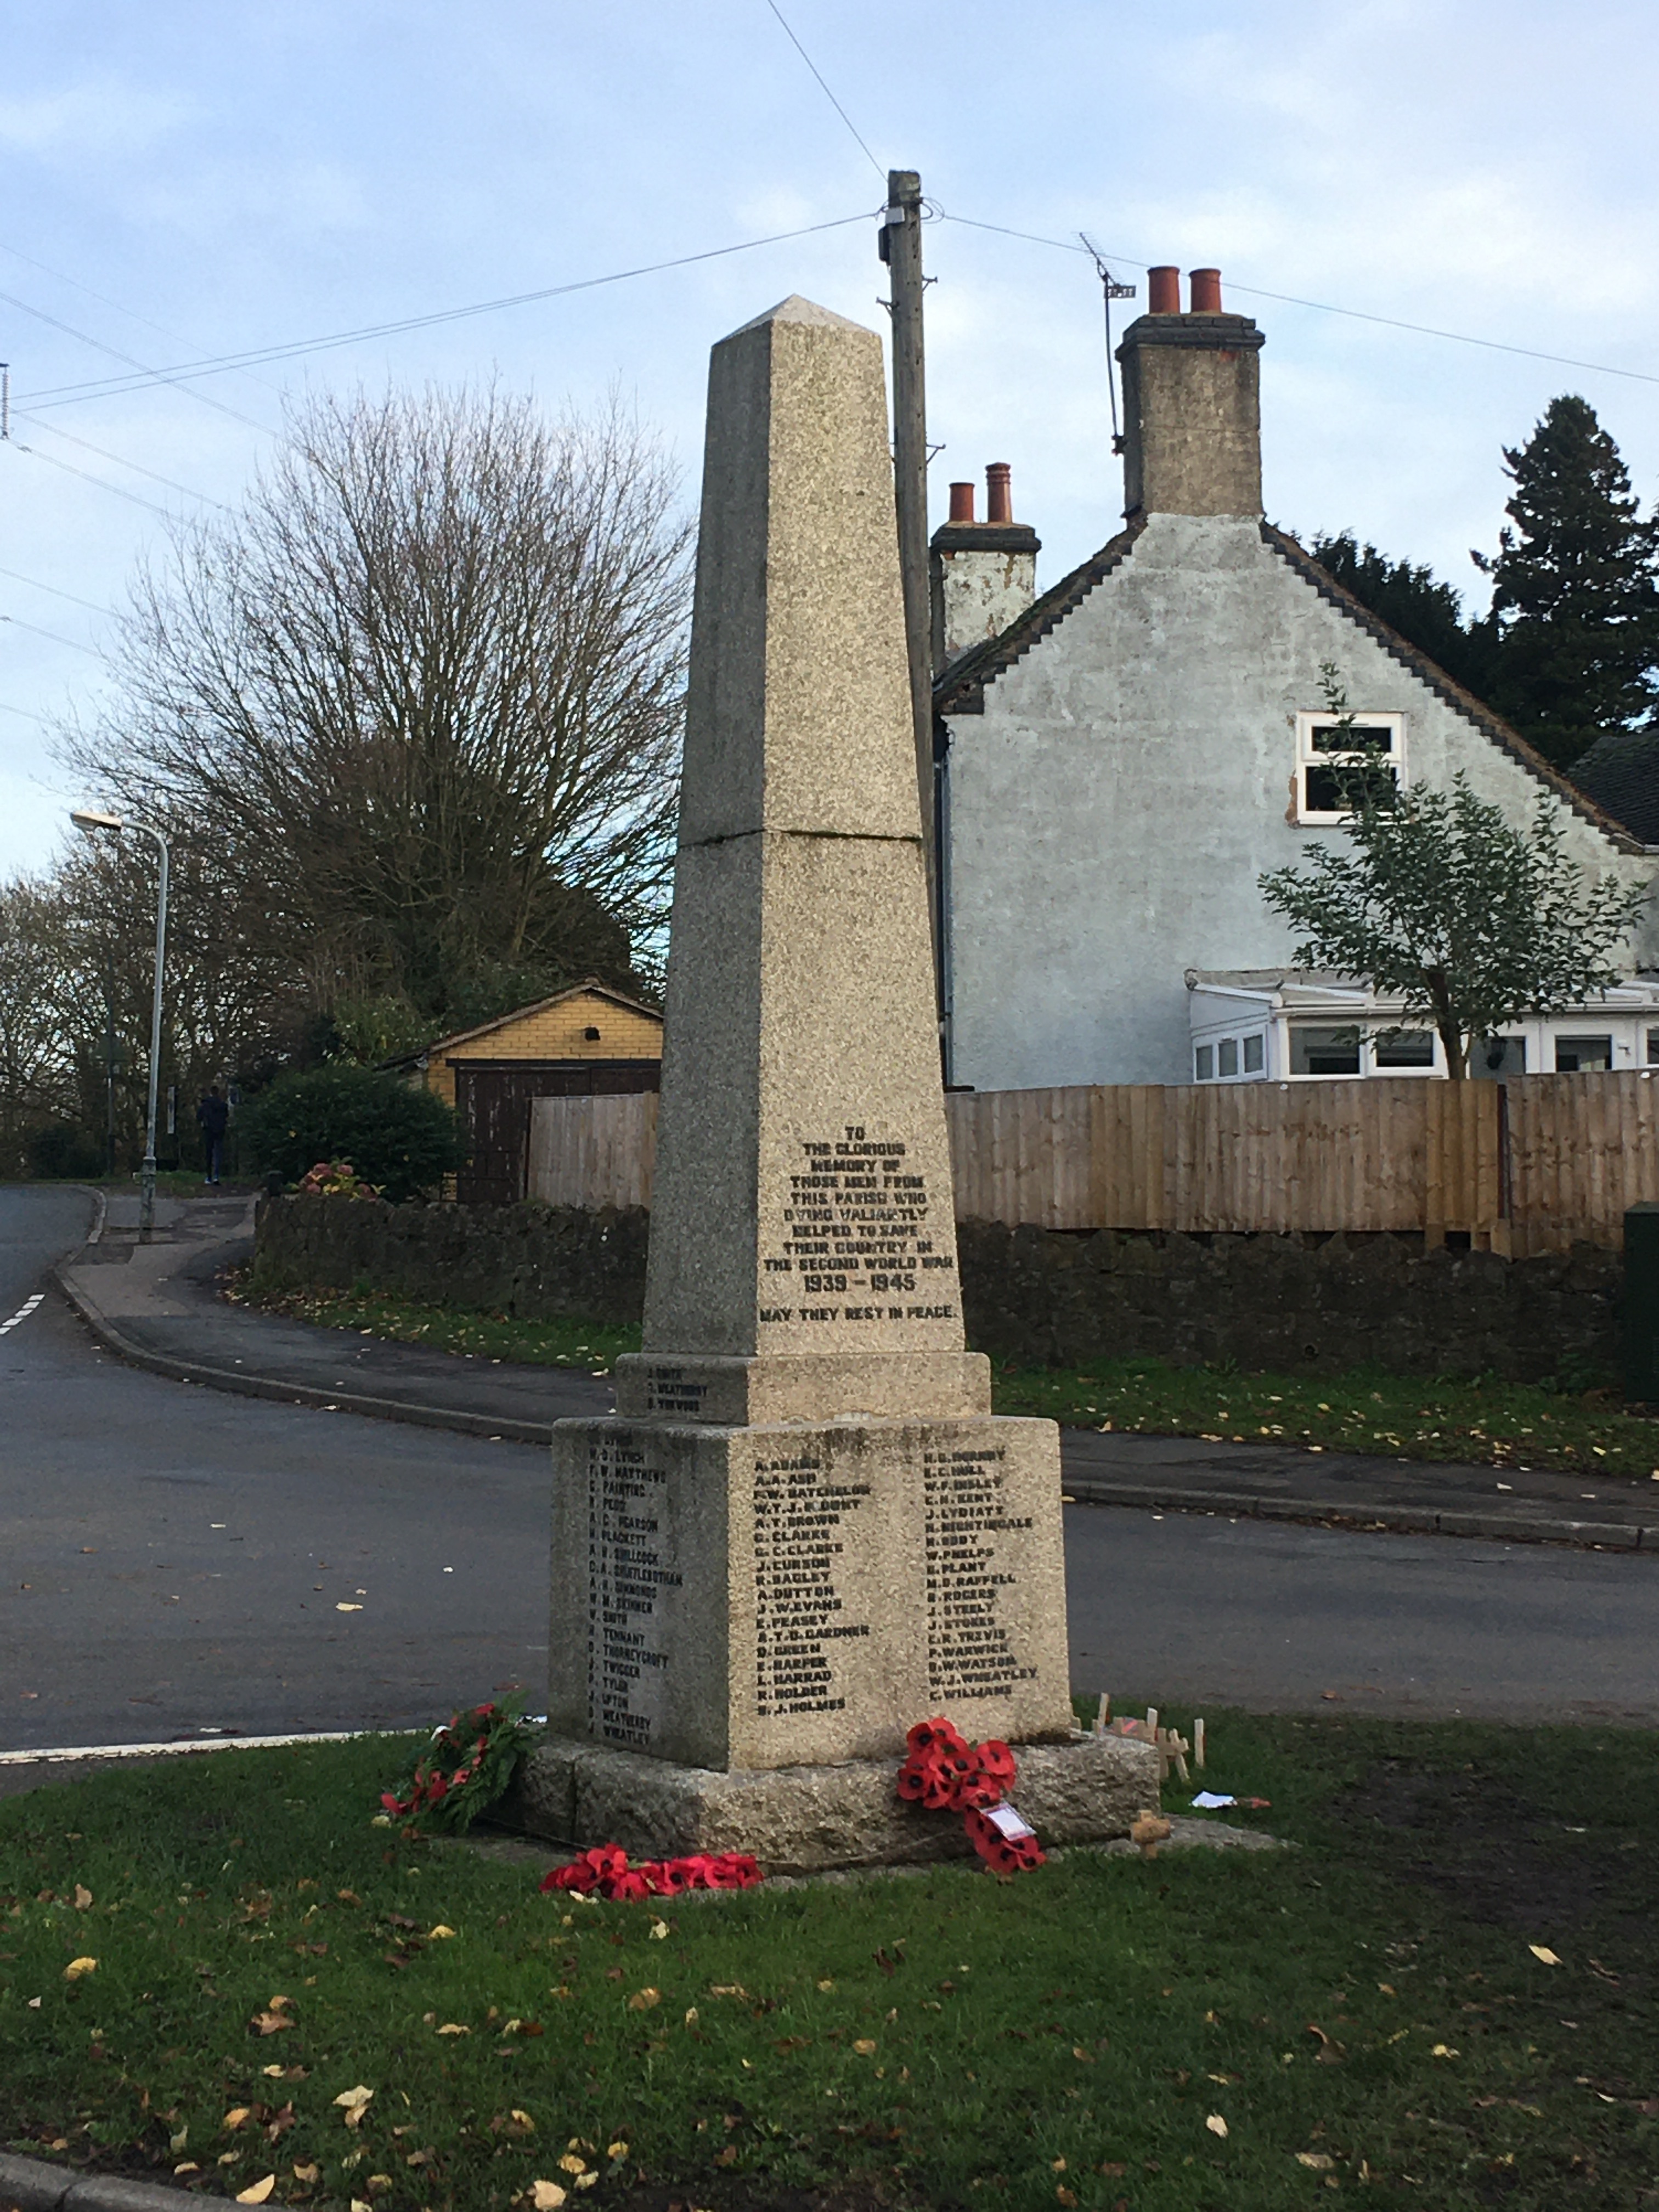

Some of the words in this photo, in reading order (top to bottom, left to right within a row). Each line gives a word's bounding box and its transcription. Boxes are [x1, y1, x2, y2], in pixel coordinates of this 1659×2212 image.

[845, 1126, 865, 1141] TO
[803, 1143, 831, 1155] THE
[836, 1143, 905, 1155] GLORIOUS
[811, 1160, 876, 1172] MEMORY
[883, 1160, 900, 1172] OF
[791, 1176, 838, 1188] THOSE
[844, 1176, 877, 1188] MEN
[884, 1176, 923, 1188] FROM
[791, 1193, 828, 1205] THIS
[835, 1192, 887, 1204] PARISH
[894, 1192, 926, 1204] WHO
[785, 1209, 832, 1221] DYING
[840, 1208, 929, 1221] VALIANTLY
[793, 1225, 851, 1238] HELPED
[857, 1226, 876, 1237] TO
[879, 1225, 917, 1237] SAVE
[783, 1242, 829, 1254] THEIR
[835, 1241, 907, 1254] COUNTRY
[917, 1241, 932, 1253] IN
[764, 1259, 792, 1271] THE
[799, 1258, 859, 1271] SECOND
[865, 1257, 916, 1269] WORLD
[921, 1257, 953, 1268] WAR
[804, 1274, 847, 1293] 1939
[871, 1274, 915, 1292] 1945
[760, 1308, 792, 1322] MAY
[799, 1308, 839, 1321] THEY
[845, 1307, 883, 1320] REST
[889, 1307, 903, 1319] IN
